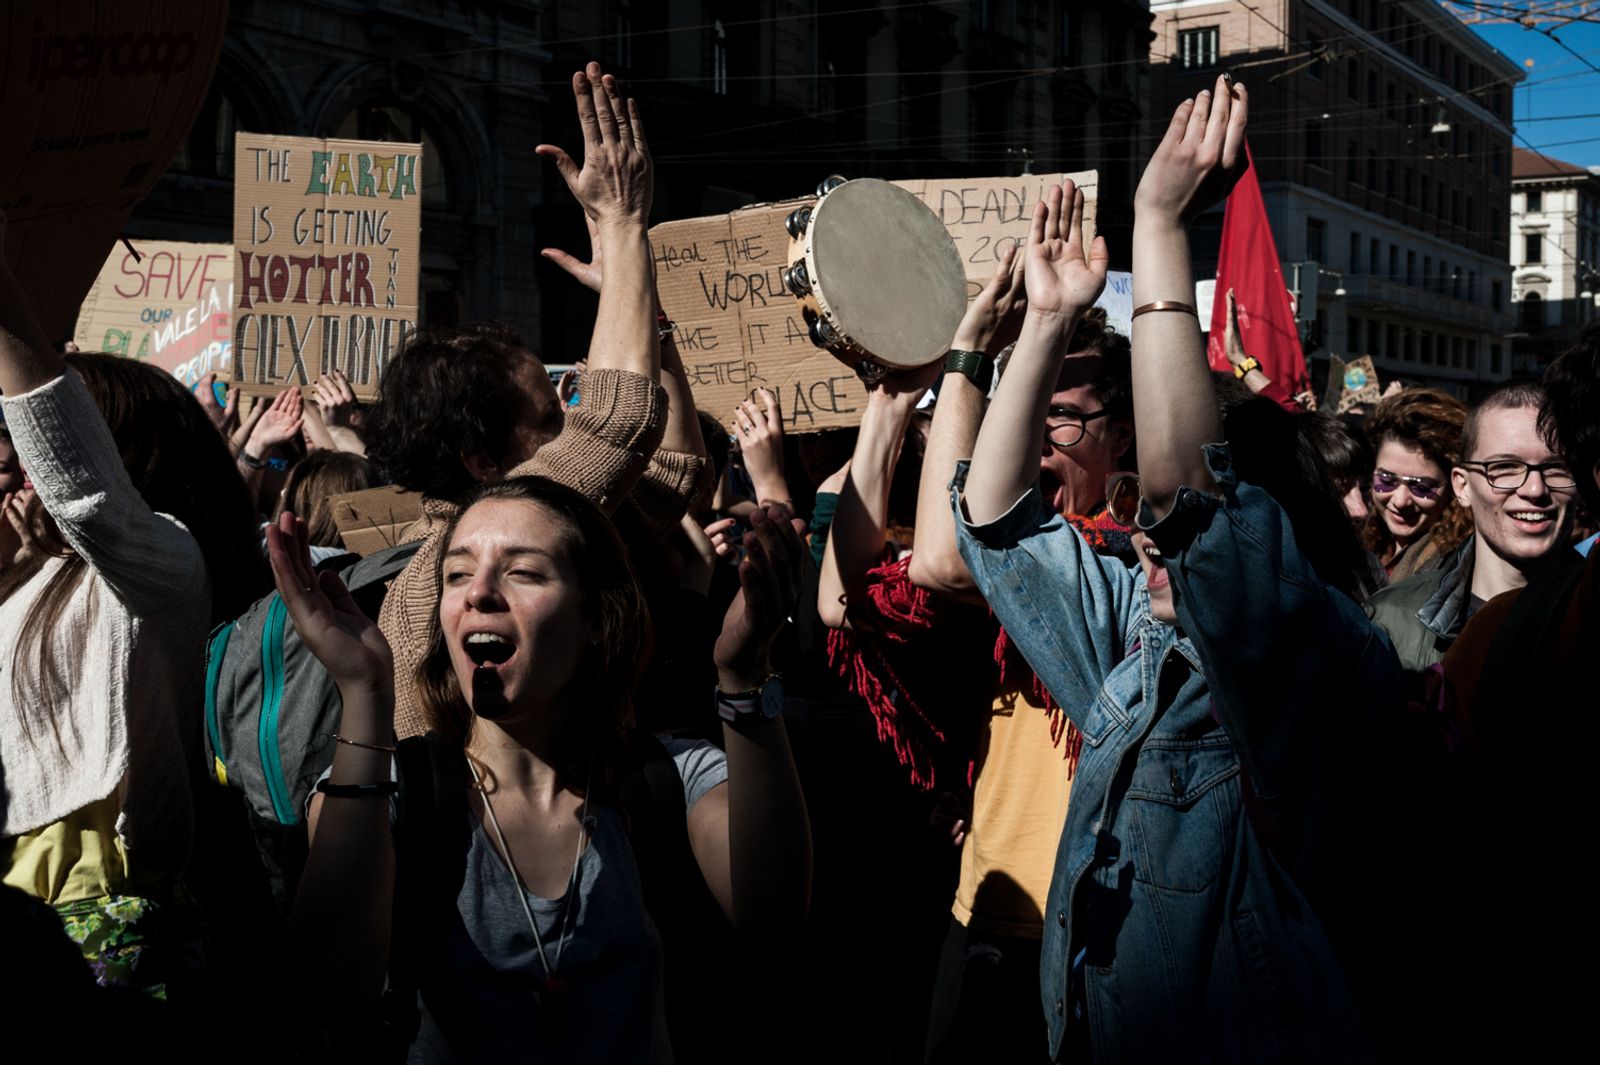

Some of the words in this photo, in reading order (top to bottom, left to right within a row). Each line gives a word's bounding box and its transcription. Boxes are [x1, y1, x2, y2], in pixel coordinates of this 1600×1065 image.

[27, 17, 196, 92] ipercoop
[246, 147, 291, 182] THE
[304, 151, 419, 200] EARTH
[252, 207, 274, 245] IS
[294, 208, 393, 245] GETTING
[238, 250, 377, 308] HOTTER
[387, 248, 400, 308] THAN
[656, 242, 707, 272] Heal
[715, 235, 769, 265] THE
[140, 308, 173, 323] OUR
[154, 307, 197, 353] VALE
[200, 287, 220, 325] LA
[675, 327, 719, 350] AKE
[748, 324, 769, 354] IT
[784, 316, 809, 345] A
[234, 313, 315, 385] ALEX
[686, 360, 767, 386] BETTER
